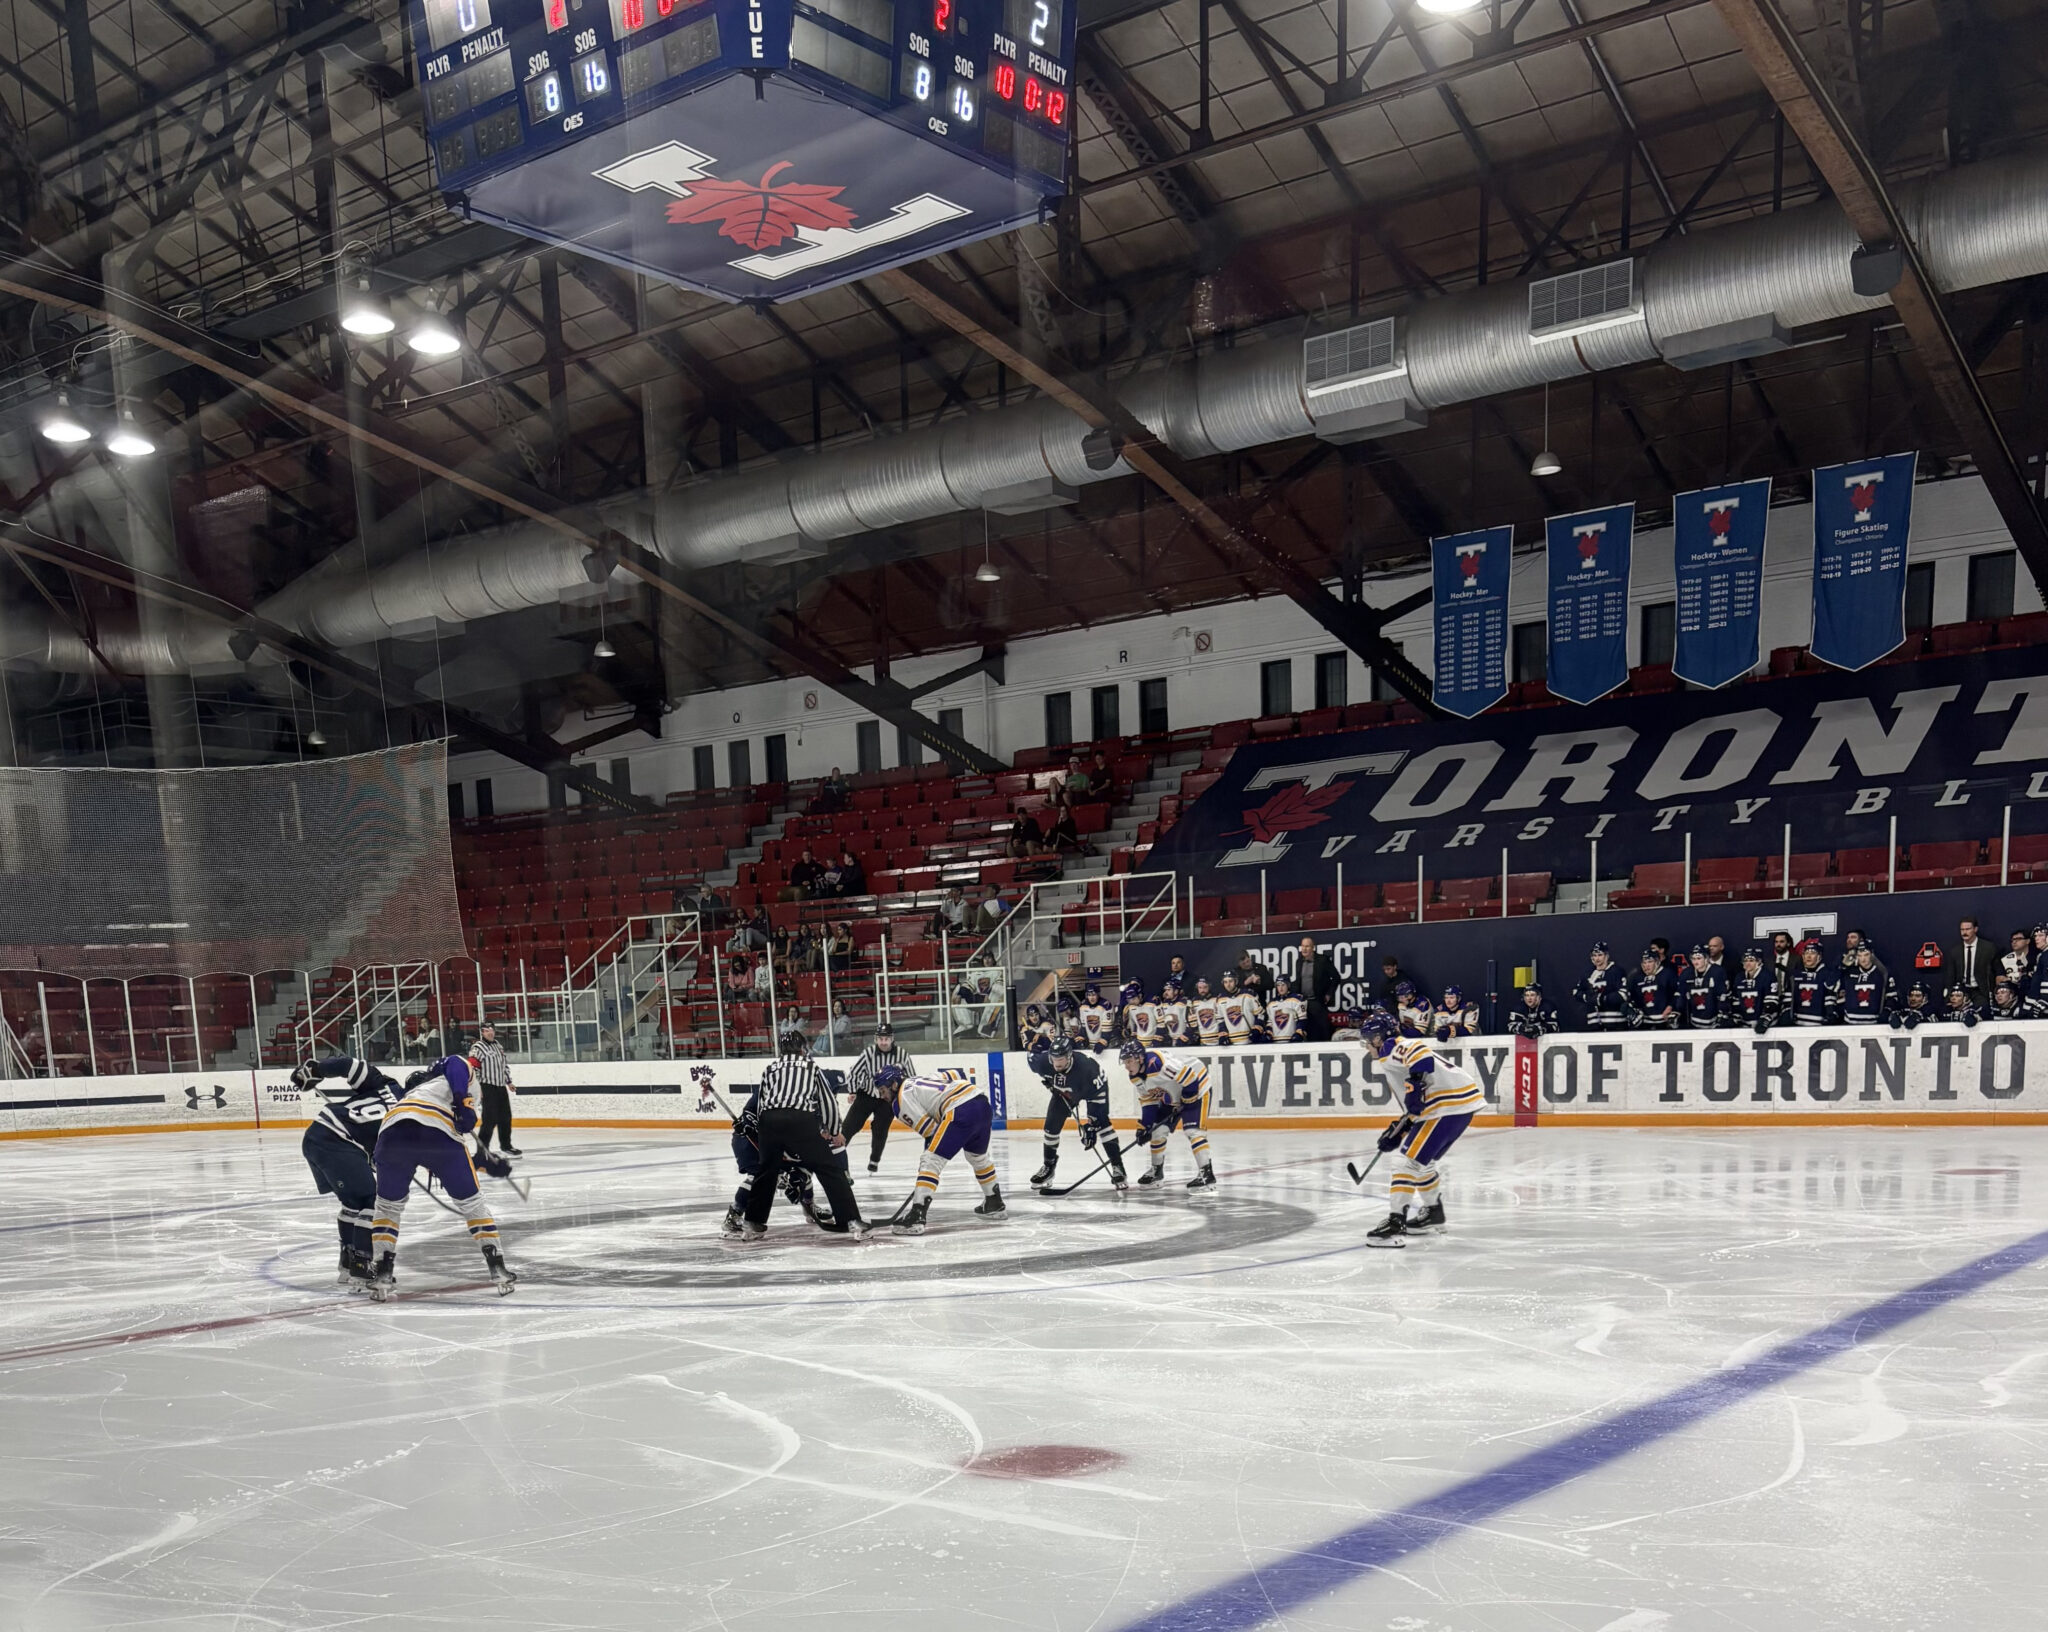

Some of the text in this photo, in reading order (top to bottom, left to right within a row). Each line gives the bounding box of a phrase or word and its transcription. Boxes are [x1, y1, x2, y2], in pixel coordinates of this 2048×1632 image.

[1030, 1, 1049, 46] 2
[574, 28, 597, 53] SOG
[909, 32, 930, 59] SOG
[426, 27, 504, 80] PLYR PENALTY
[528, 50, 550, 75] SOG
[993, 33, 1068, 86] PLYR PENALTY
[584, 60, 607, 93] 16
[954, 55, 974, 80] SOG
[544, 77, 559, 112] 8
[915, 66, 931, 100] 8
[995, 65, 1064, 125] 10 0:12
[954, 86, 973, 122] 16
[563, 112, 584, 133] OES
[928, 116, 949, 136] OES
[1834, 523, 1889, 538] Figure Skating
[1691, 552, 1717, 561] Hockey
[1721, 547, 1748, 556] Women
[1119, 650, 1128, 663] R
[1125, 832, 1131, 841] K
[1320, 797, 1771, 858] VARSITY
[1102, 858, 1108, 867] J
[771, 1060, 808, 1071] SUTTON
[1392, 1045, 1408, 1064] 12
[1163, 1067, 1177, 1080] 11
[1543, 1044, 1623, 1103] OF
[1651, 1034, 2026, 1103] TORONTO
[267, 1085, 302, 1094] PANAG
[993, 1072, 1003, 1118] CCM
[1518, 1056, 1531, 1109] CCM
[273, 1094, 302, 1102] PIZZA
[344, 1097, 388, 1124] 19
